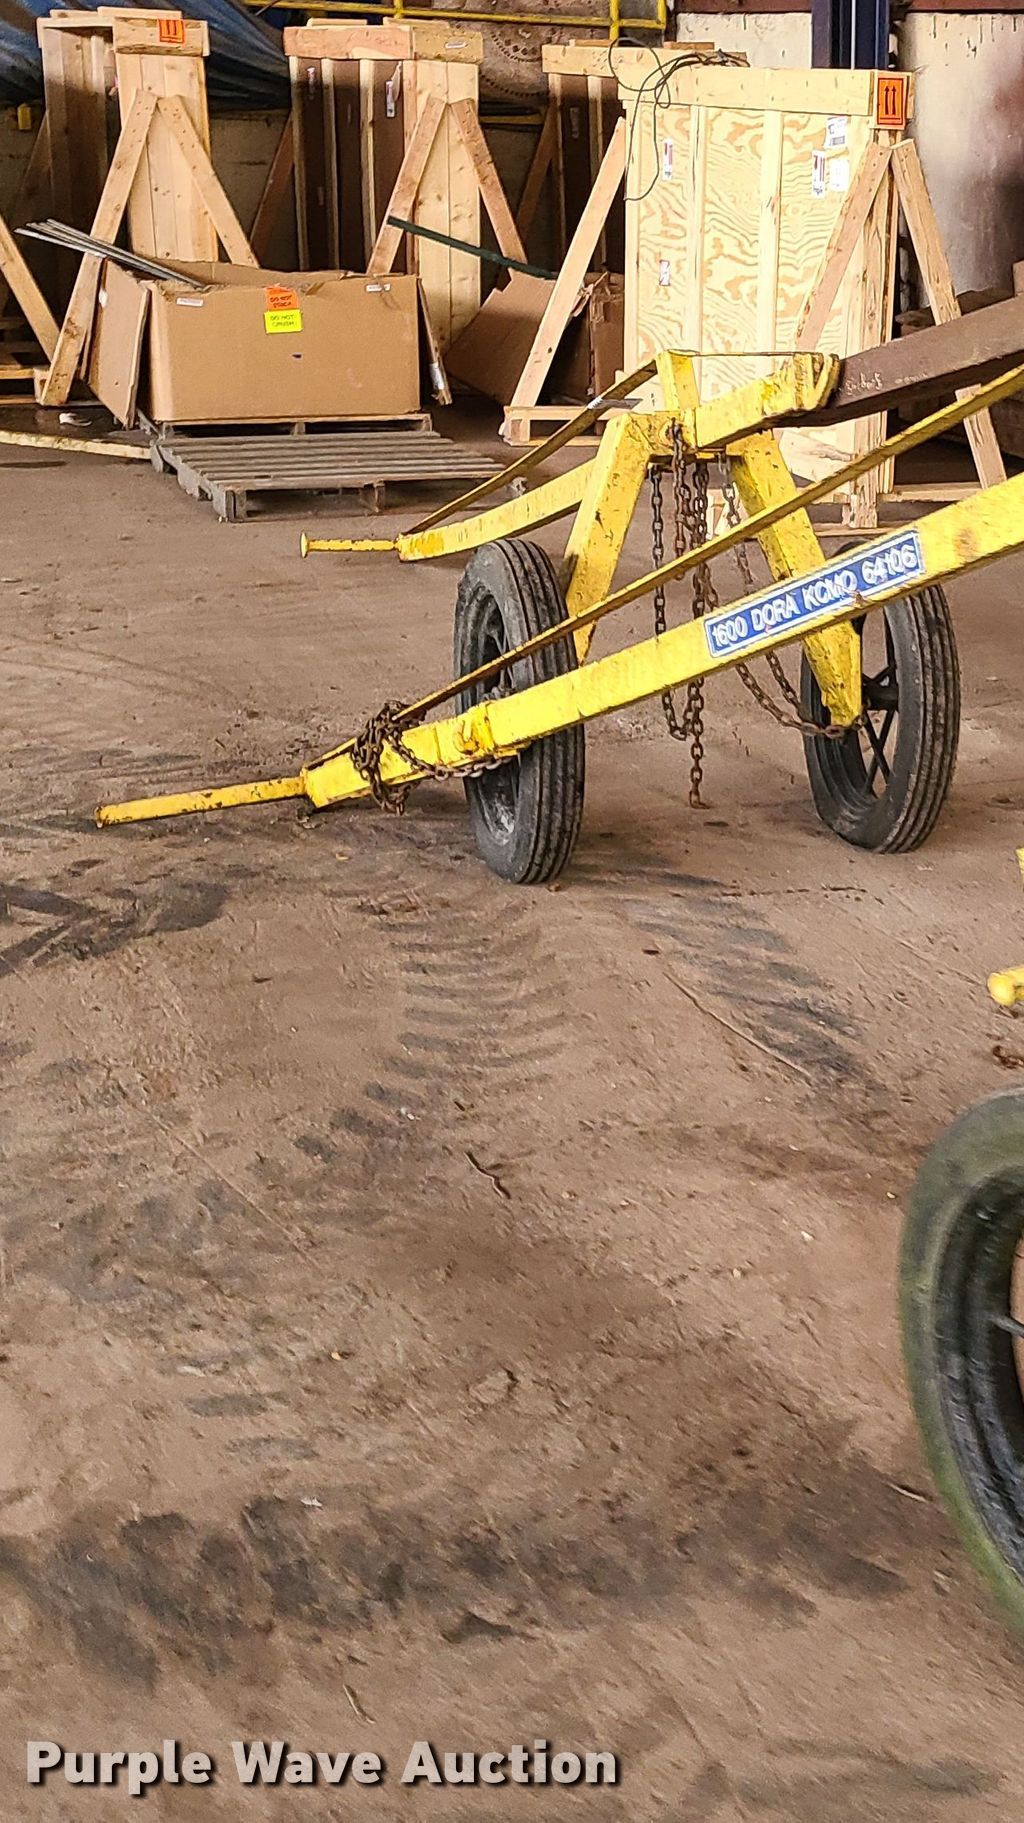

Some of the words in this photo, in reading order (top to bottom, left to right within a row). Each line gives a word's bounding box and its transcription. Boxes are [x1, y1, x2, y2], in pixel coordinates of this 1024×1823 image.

[712, 616, 748, 647] 1600
[751, 594, 800, 631] DORA
[861, 544, 918, 585] 64106
